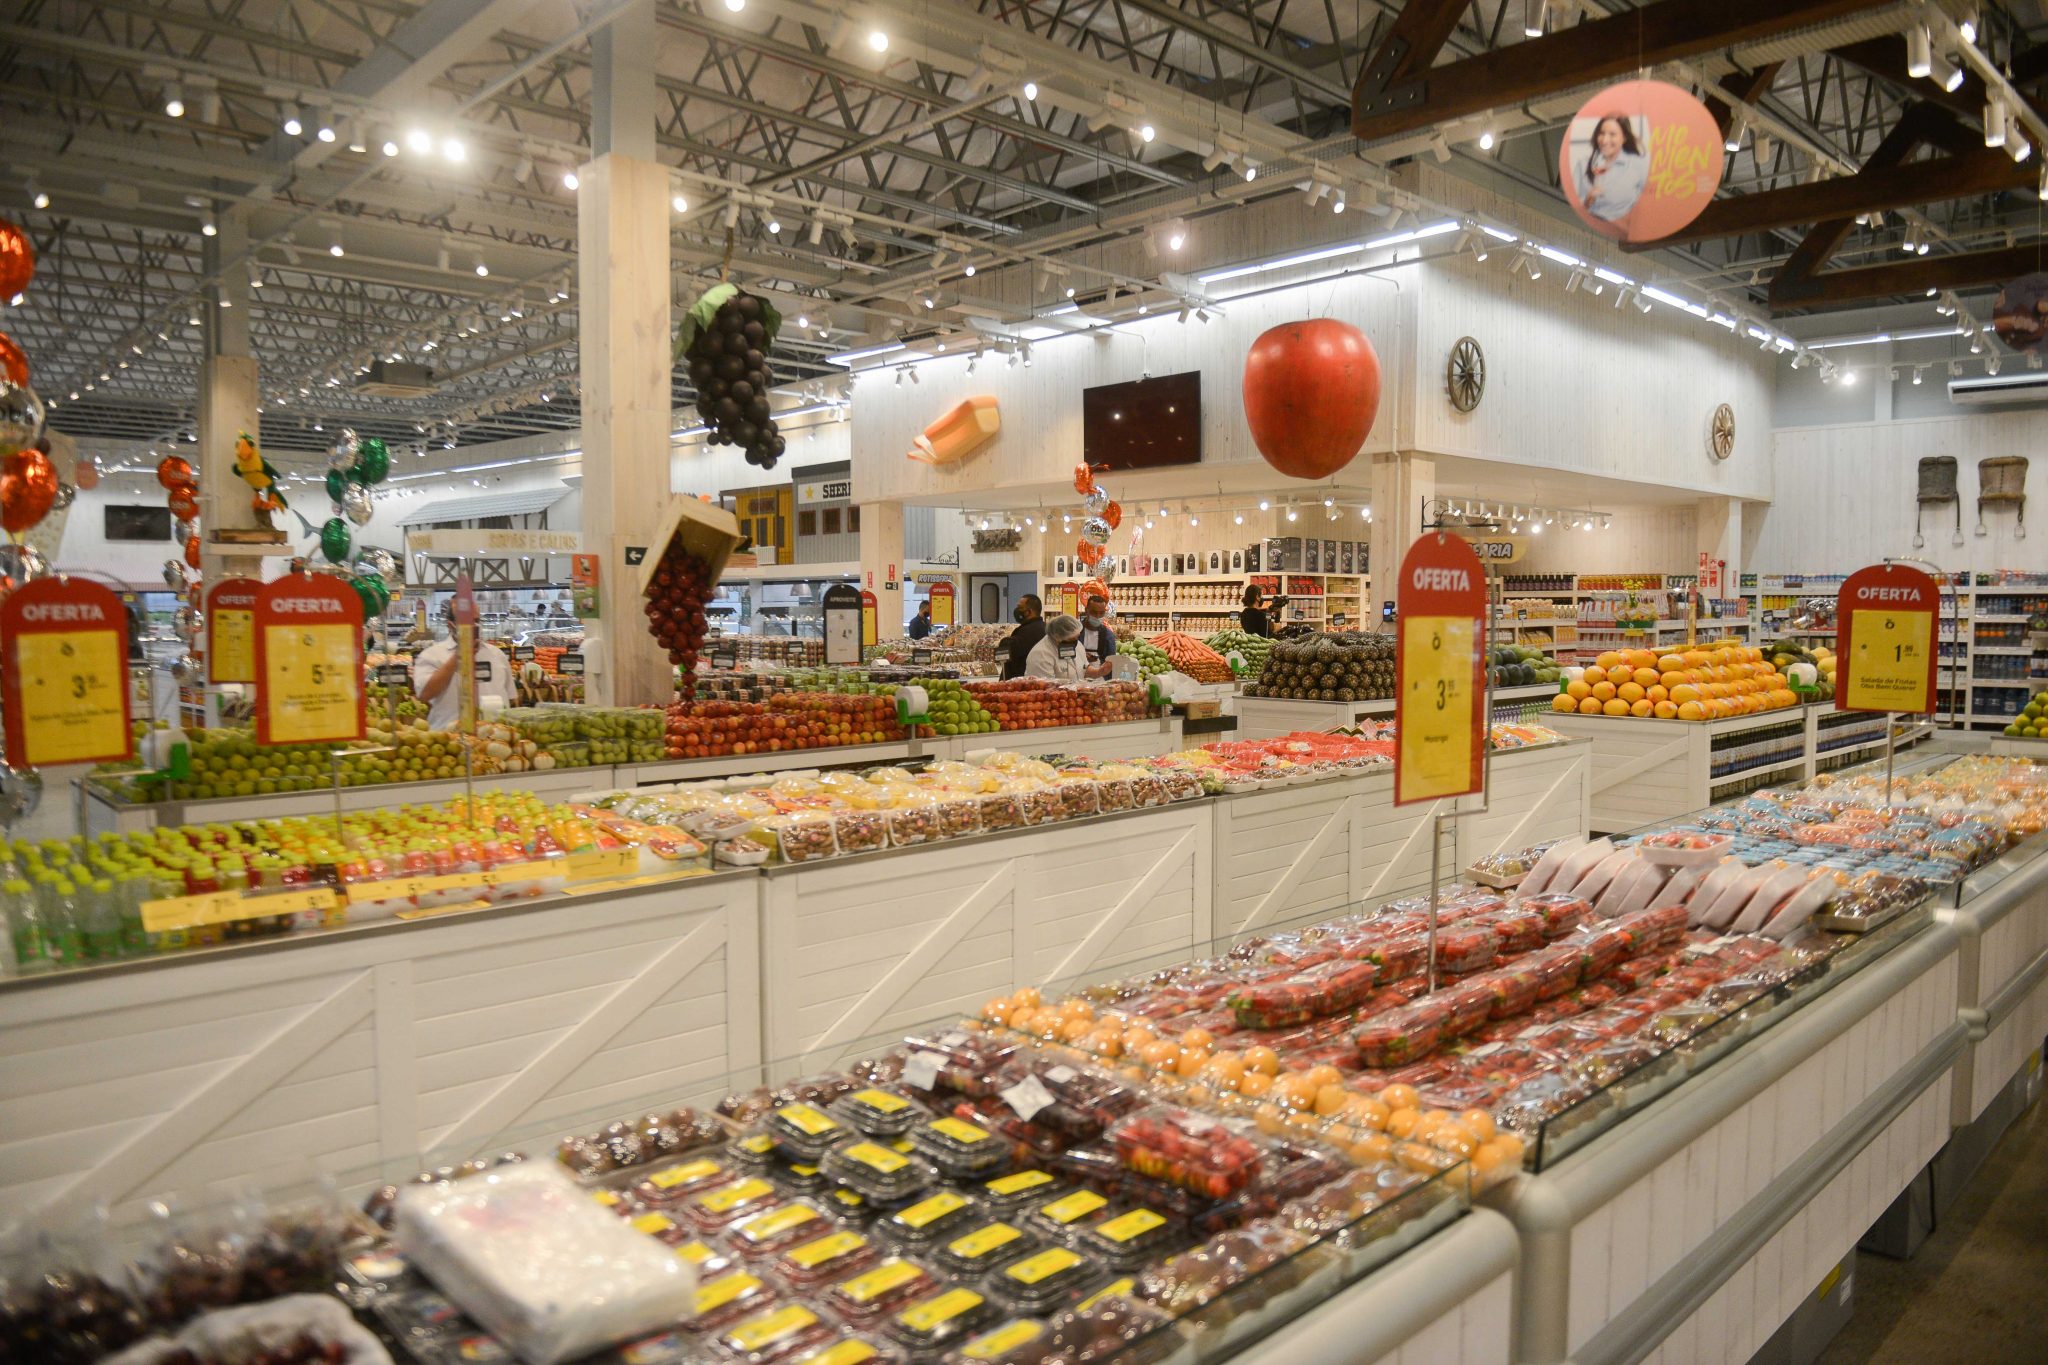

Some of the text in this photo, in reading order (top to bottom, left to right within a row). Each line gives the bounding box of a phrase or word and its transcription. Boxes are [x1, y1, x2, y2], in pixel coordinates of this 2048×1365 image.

[1413, 568, 1470, 591] OFERTA
[1857, 587, 1921, 601] OFERTA
[22, 604, 104, 621] OFERTA
[271, 598, 343, 613] OFERTA
[1894, 645, 1901, 662] 1
[312, 664, 325, 684] 5
[72, 675, 86, 698] 3
[1436, 680, 1446, 711] 3
